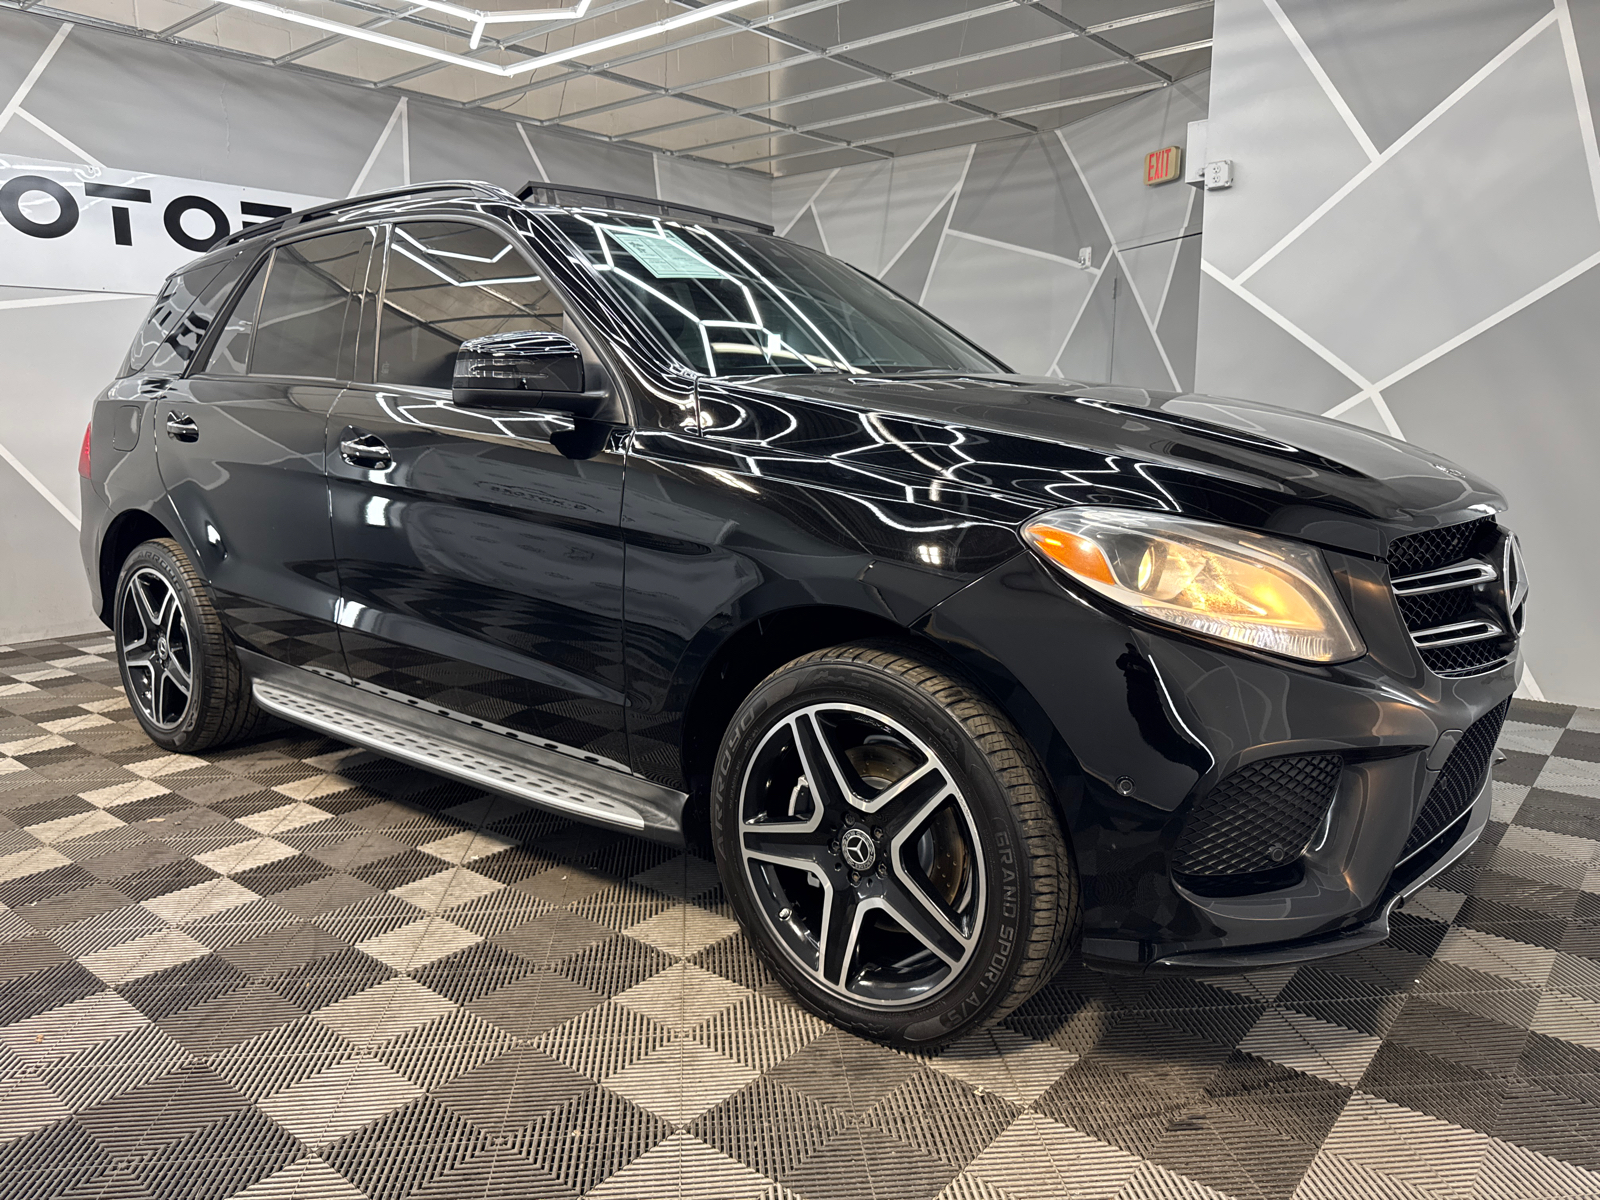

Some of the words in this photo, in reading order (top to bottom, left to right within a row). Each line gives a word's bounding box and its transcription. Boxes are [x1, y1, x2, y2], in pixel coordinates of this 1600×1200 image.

[1147, 148, 1172, 182] EXIT
[714, 706, 756, 861] ARROYO
[994, 831, 1018, 919] GRAND
[979, 923, 1015, 995] SPORT
[946, 991, 981, 1023] A/S
